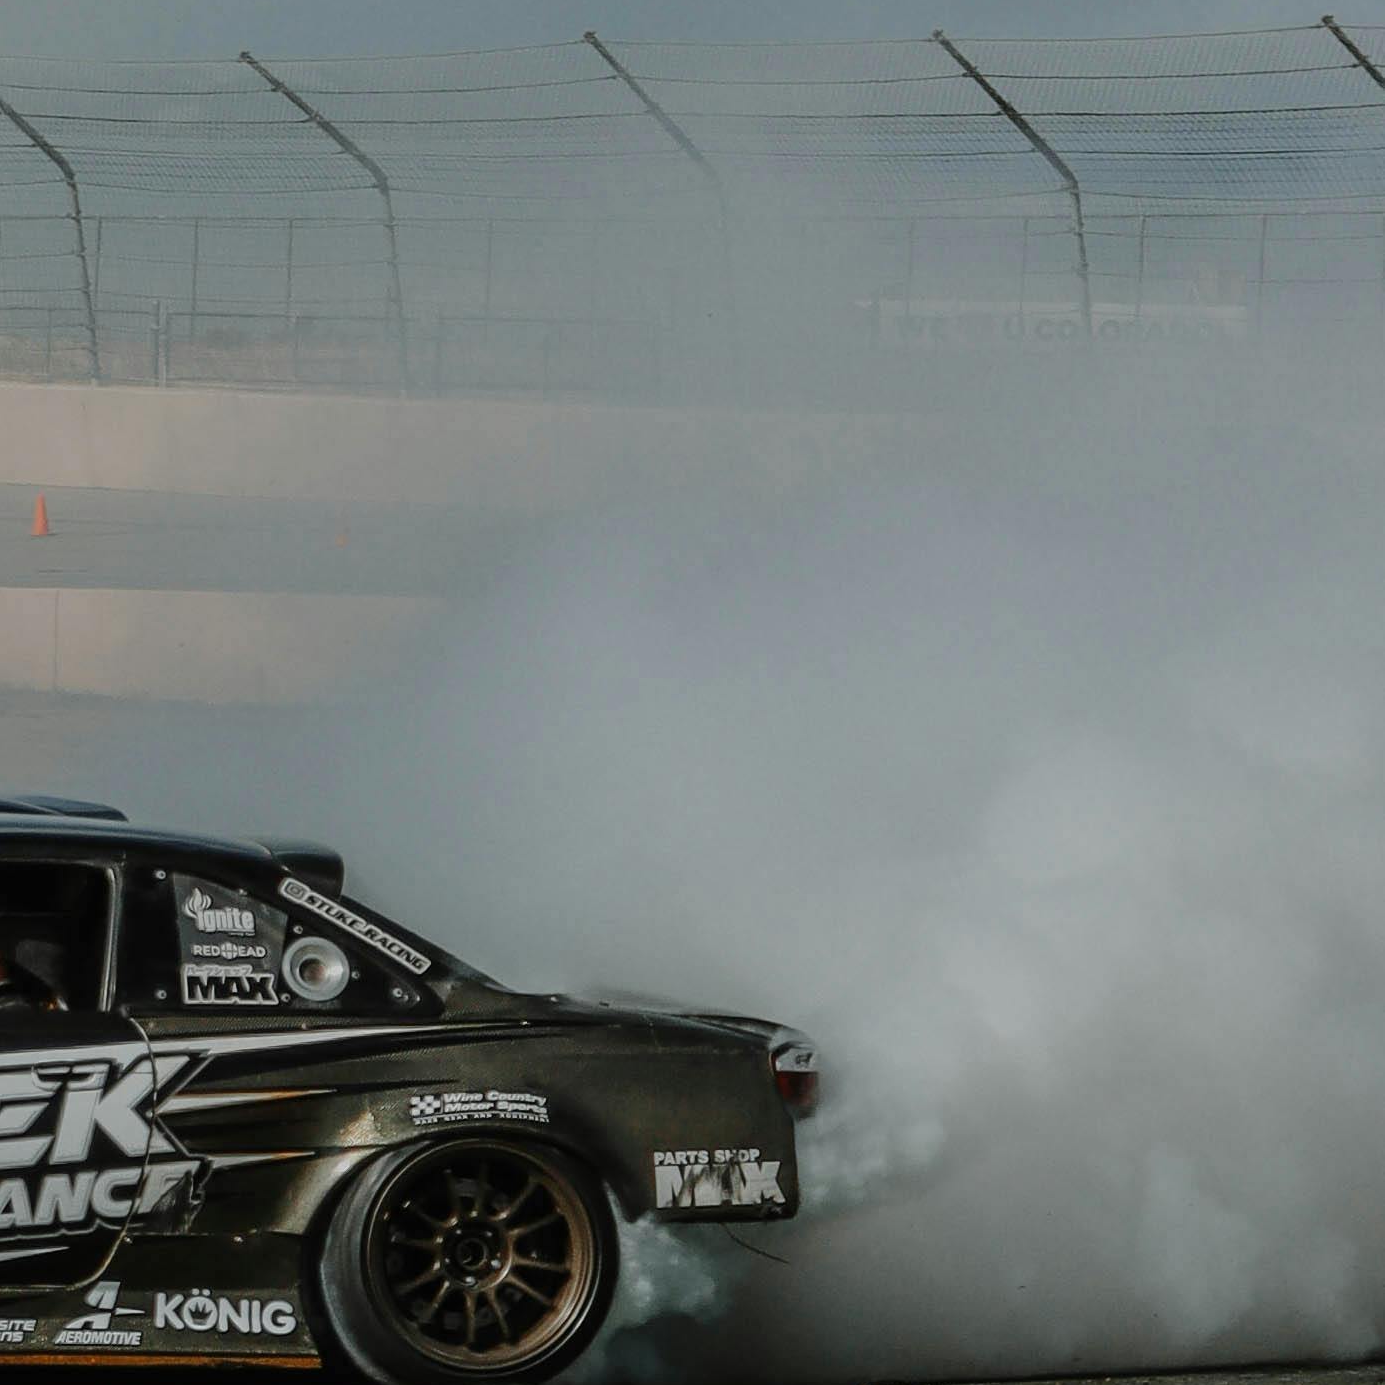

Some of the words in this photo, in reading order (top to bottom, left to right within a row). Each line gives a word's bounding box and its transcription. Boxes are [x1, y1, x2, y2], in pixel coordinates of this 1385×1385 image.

[186, 975, 275, 1002] MAX
[442, 1092, 484, 1103] Wine
[485, 1090, 547, 1106] Country
[653, 1150, 710, 1165] PARTS
[714, 1148, 761, 1163] SHOP
[154, 1288, 297, 1336] KÖNIG
[54, 1331, 143, 1346] AEROMOTIVE
